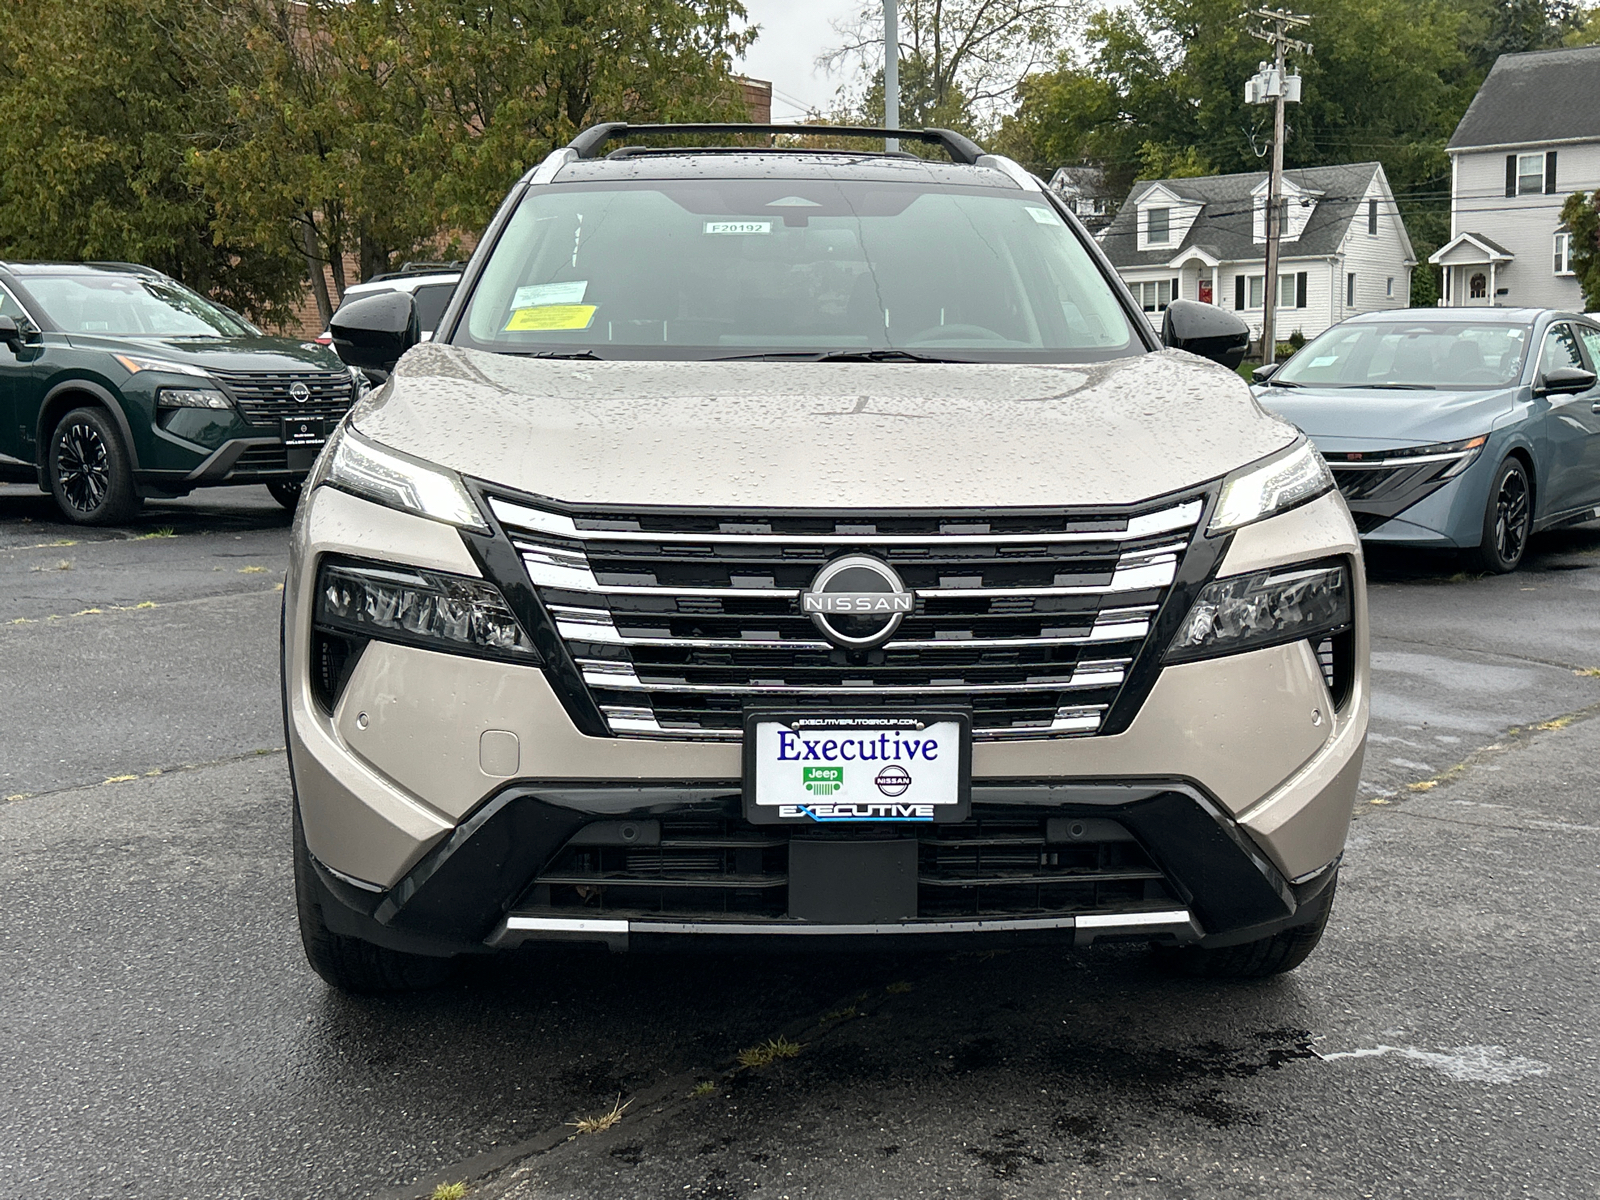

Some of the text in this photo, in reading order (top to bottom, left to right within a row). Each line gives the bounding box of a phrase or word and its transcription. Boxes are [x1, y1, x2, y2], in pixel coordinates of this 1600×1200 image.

[712, 224, 763, 232] F20192
[806, 597, 910, 610] NISSAN
[798, 718, 918, 726] EXECUTIVEAUTOGROUP.COM
[777, 730, 939, 761] Executive
[808, 768, 838, 780] Jeep
[876, 777, 910, 785] NISSAN
[778, 804, 935, 818] EXECUTIVE
